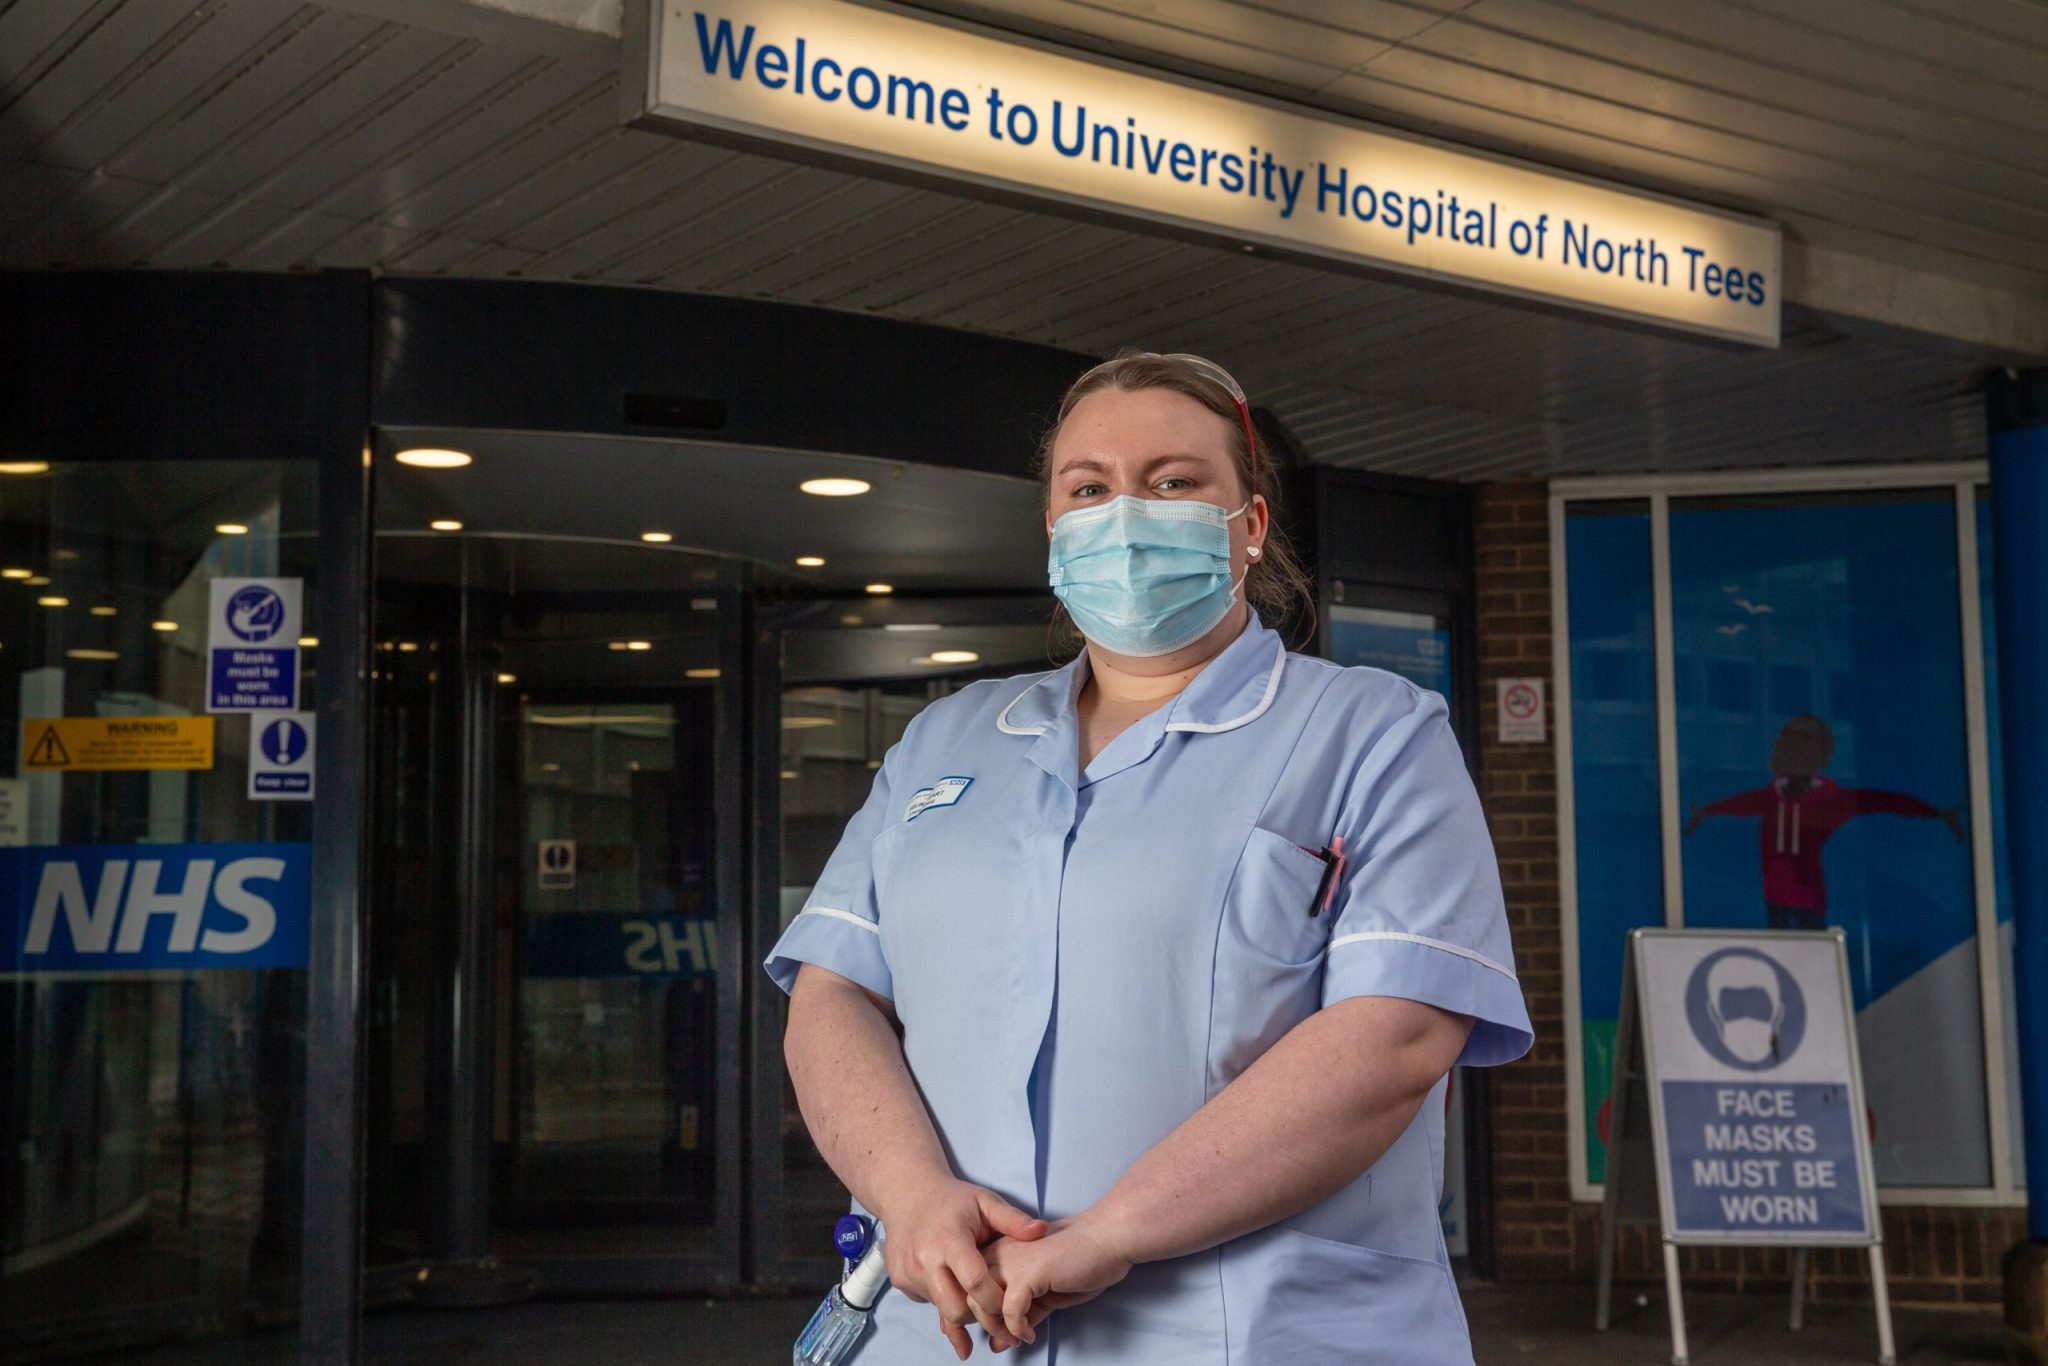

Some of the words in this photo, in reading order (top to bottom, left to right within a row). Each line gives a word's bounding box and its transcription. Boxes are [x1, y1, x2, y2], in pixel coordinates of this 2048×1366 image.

[693, 12, 971, 132] Welcome
[987, 88, 1038, 145] to
[1052, 100, 1304, 218] University
[1317, 163, 1497, 247] Hospital
[1509, 214, 1548, 258] of
[1563, 220, 1668, 286] North
[1682, 246, 1765, 306] Tees
[227, 667, 260, 678] must
[262, 667, 280, 678] be
[233, 651, 275, 664] Masks
[217, 694, 231, 706] in
[232, 693, 257, 706] this
[259, 695, 288, 706] area
[236, 681, 270, 692] worn
[106, 722, 178, 736] WARNING
[24, 856, 287, 954] NHS
[1716, 1088, 1797, 1118] FACE
[1703, 1123, 1817, 1154] MASKS
[1692, 1158, 1781, 1188] MUST
[1793, 1159, 1837, 1189] BE
[1719, 1194, 1820, 1225] WORN
